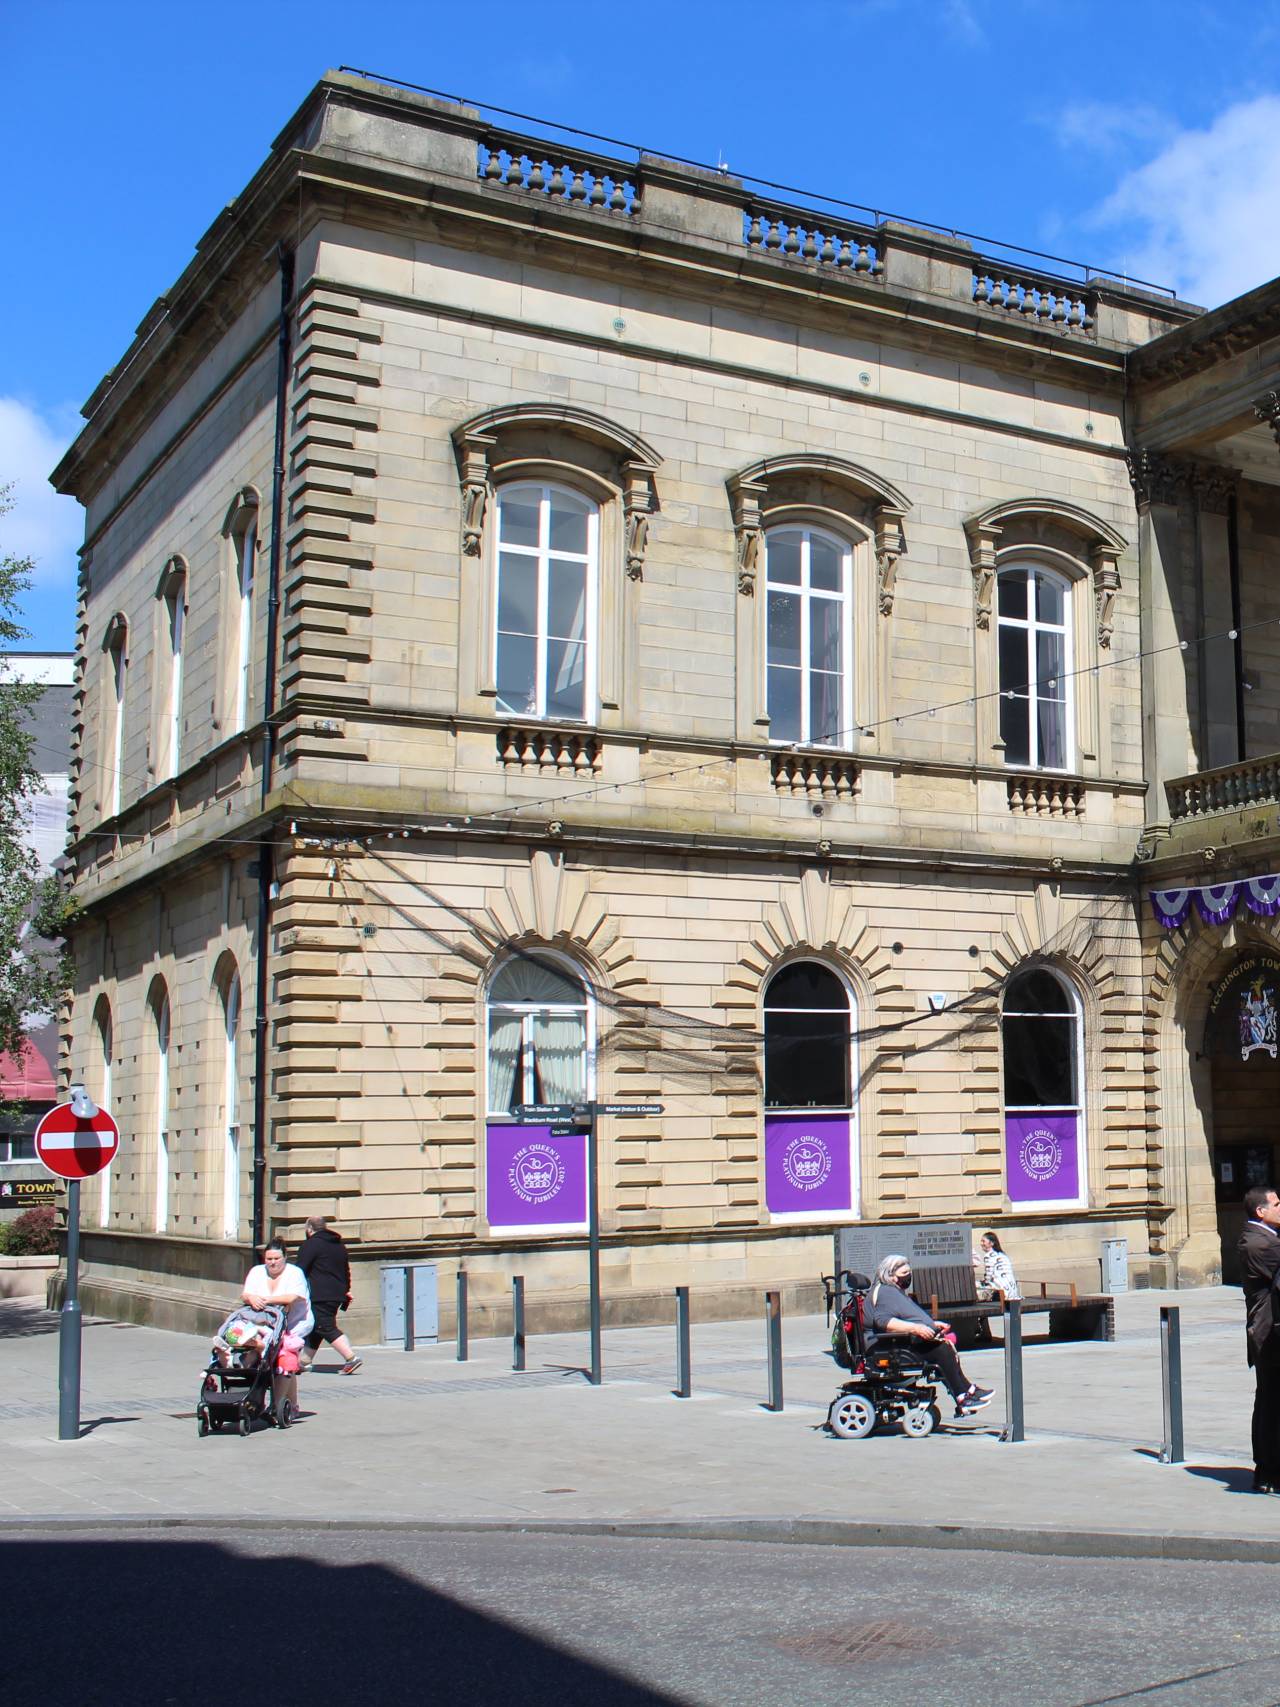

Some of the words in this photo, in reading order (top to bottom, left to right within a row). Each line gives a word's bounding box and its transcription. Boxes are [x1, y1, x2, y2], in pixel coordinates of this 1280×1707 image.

[1210, 959, 1255, 1014] ACCRINGTON
[786, 1138, 800, 1151] THE
[800, 1135, 828, 1151] QUEEN'S
[1022, 1133, 1034, 1145] THE
[1034, 1129, 1058, 1145] QUEEN'S
[512, 1147, 528, 1161] THE
[529, 1143, 561, 1161] QUEEN'S
[782, 1158, 804, 1190] PLATINUM
[804, 1173, 829, 1192] JUBILEE
[1019, 1150, 1038, 1180] PLATINUM
[1038, 1165, 1060, 1183] JUBILEE
[16, 1183, 55, 1193] TOWN
[508, 1168, 532, 1202] PLATINUM
[533, 1184, 562, 1205] JUBILEE
